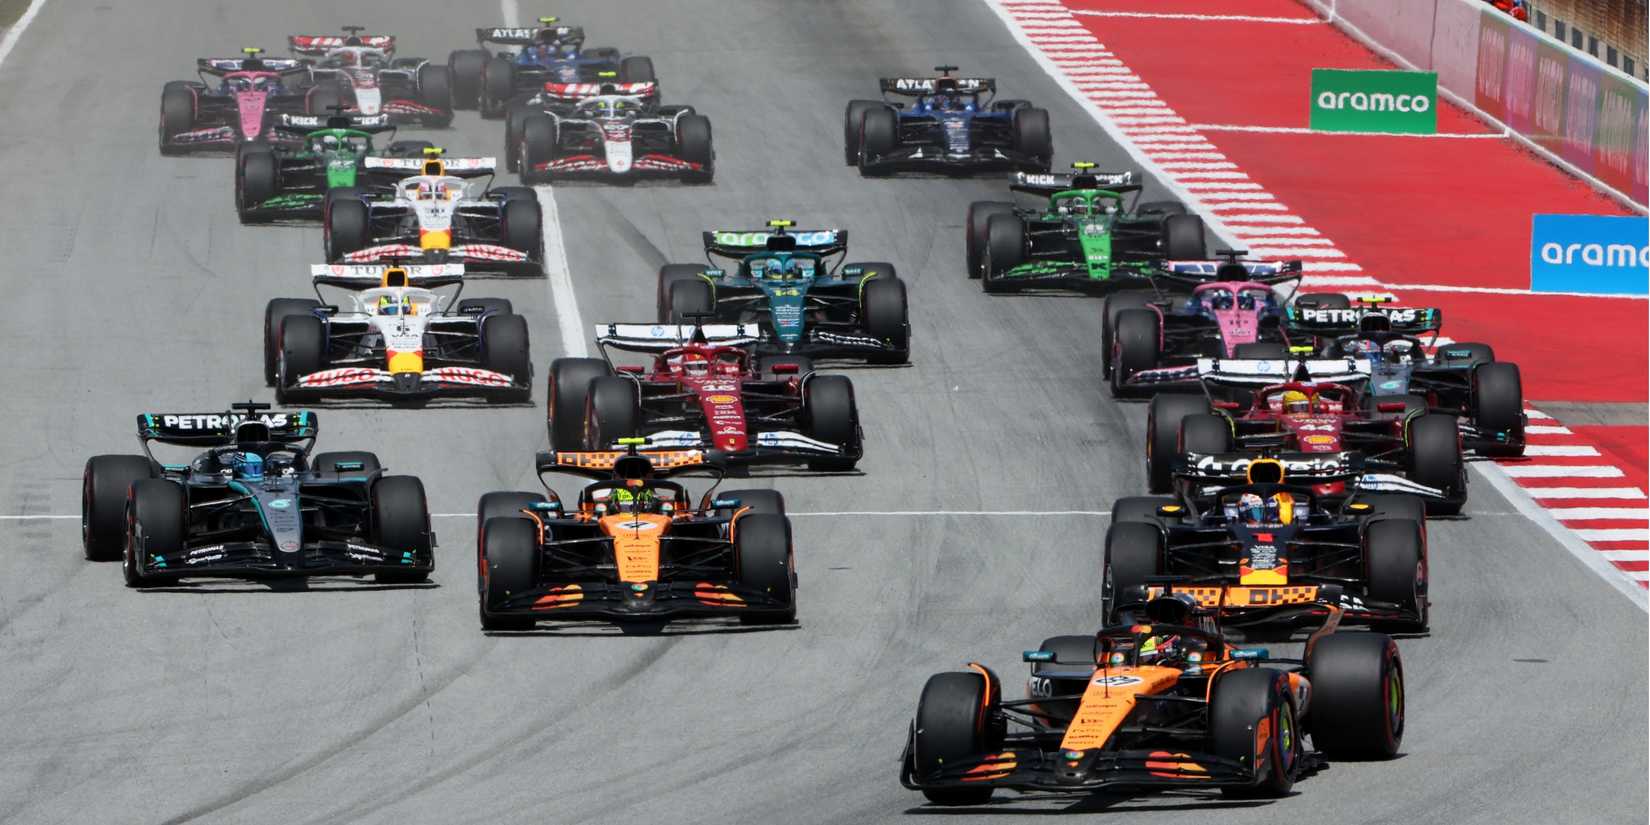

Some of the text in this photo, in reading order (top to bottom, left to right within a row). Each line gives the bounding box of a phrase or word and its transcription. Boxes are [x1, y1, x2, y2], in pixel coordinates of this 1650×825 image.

[1317, 92, 1429, 112] aramco
[1026, 175, 1055, 184] KICK
[720, 232, 831, 246] araco
[305, 368, 376, 386] HUGO
[439, 368, 512, 385] HUGO
